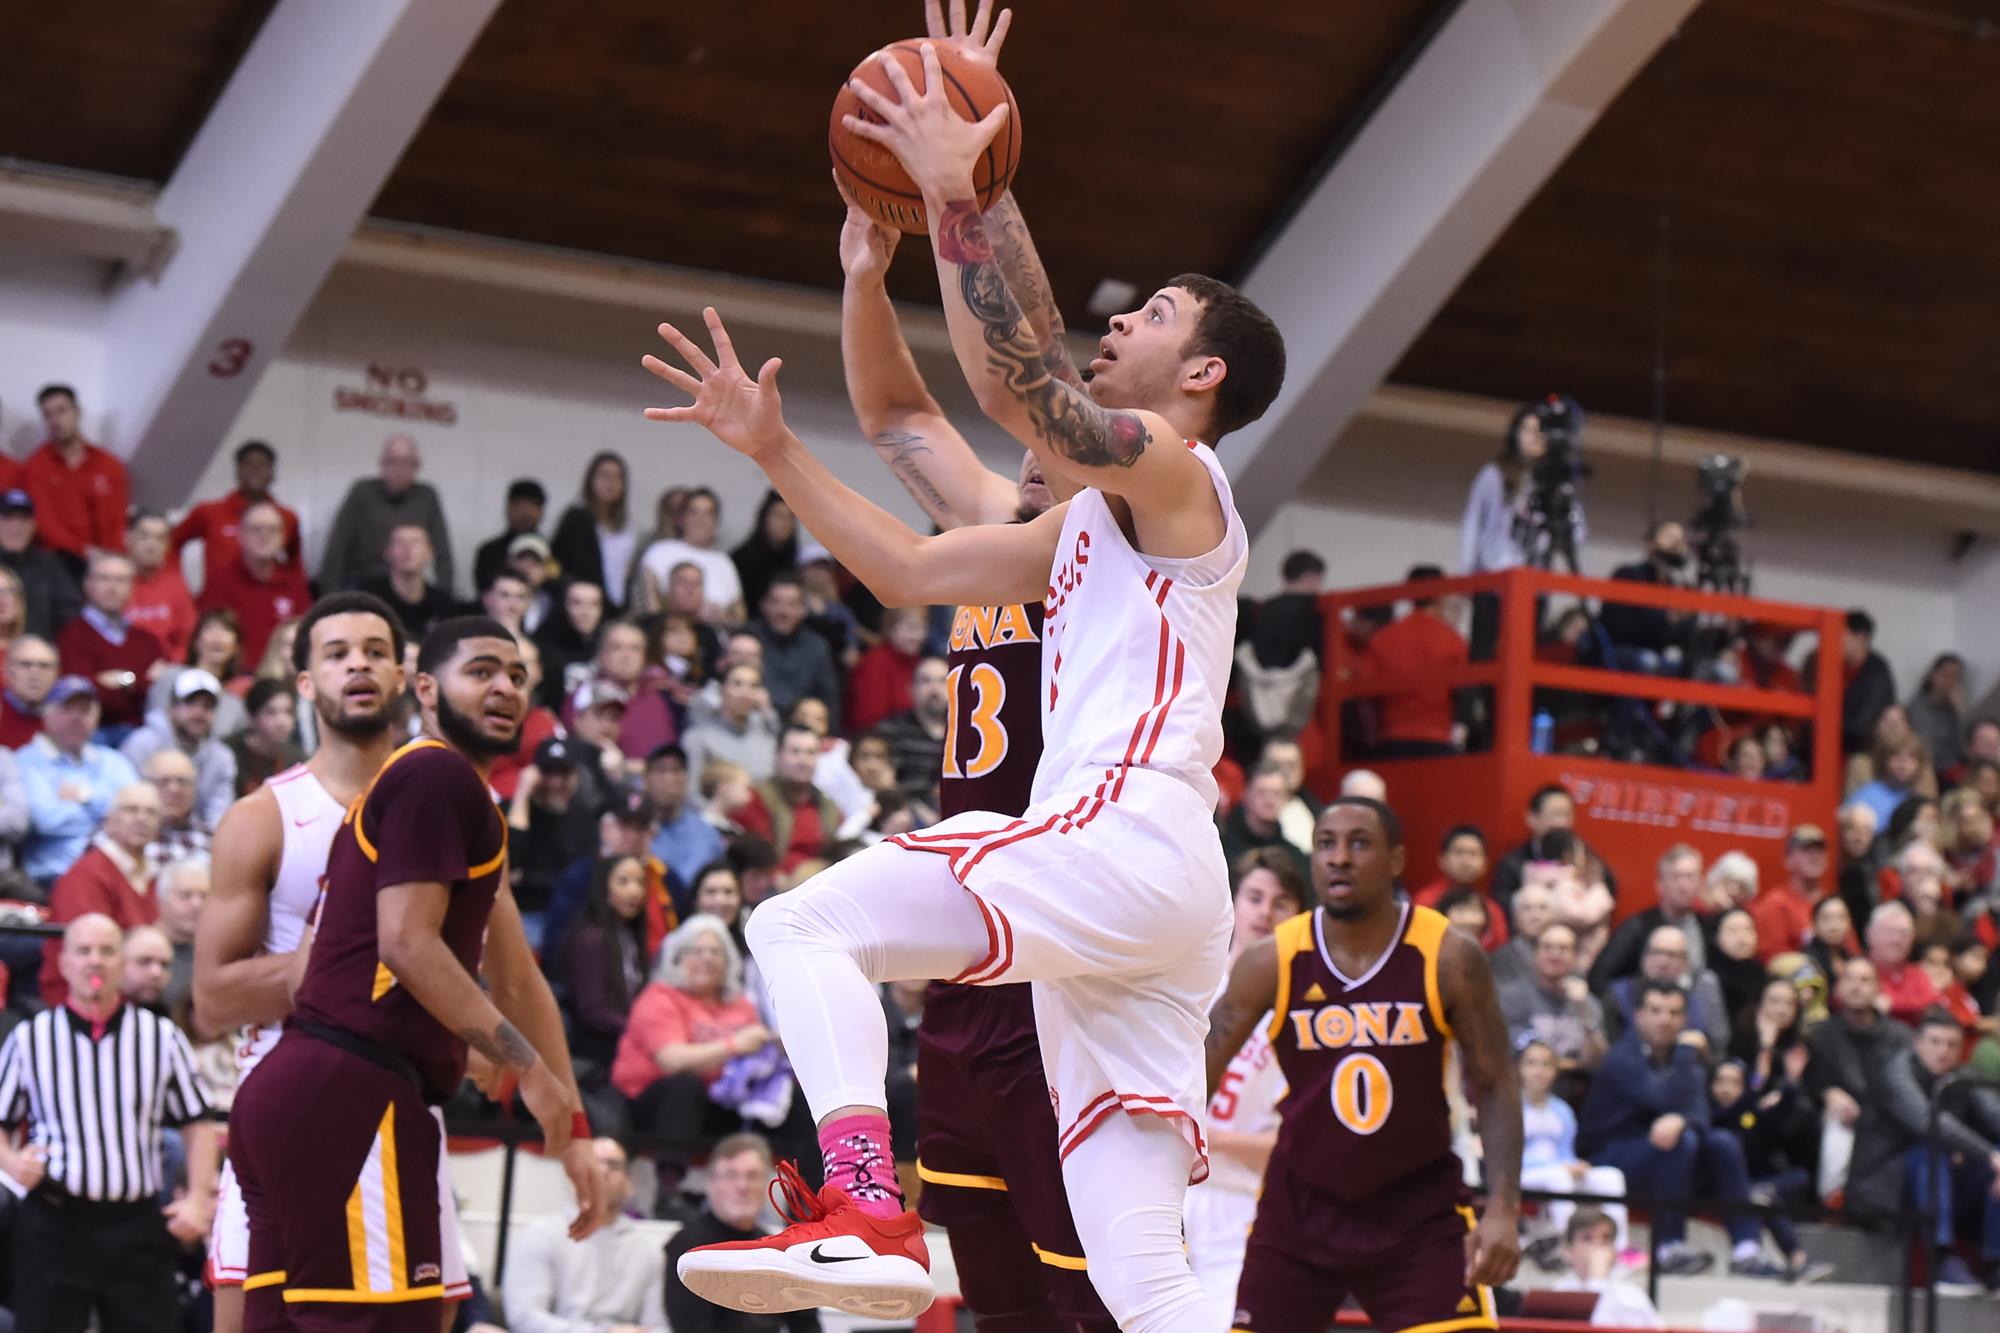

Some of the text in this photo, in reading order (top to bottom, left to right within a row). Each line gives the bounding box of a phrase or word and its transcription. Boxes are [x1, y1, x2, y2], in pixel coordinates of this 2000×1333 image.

[207, 337, 253, 379] 3
[365, 360, 427, 396] NO
[949, 604, 1040, 652] ONA
[942, 662, 1009, 779] 13
[1289, 1001, 1429, 1050] IONA
[1331, 1052, 1393, 1136] 0
